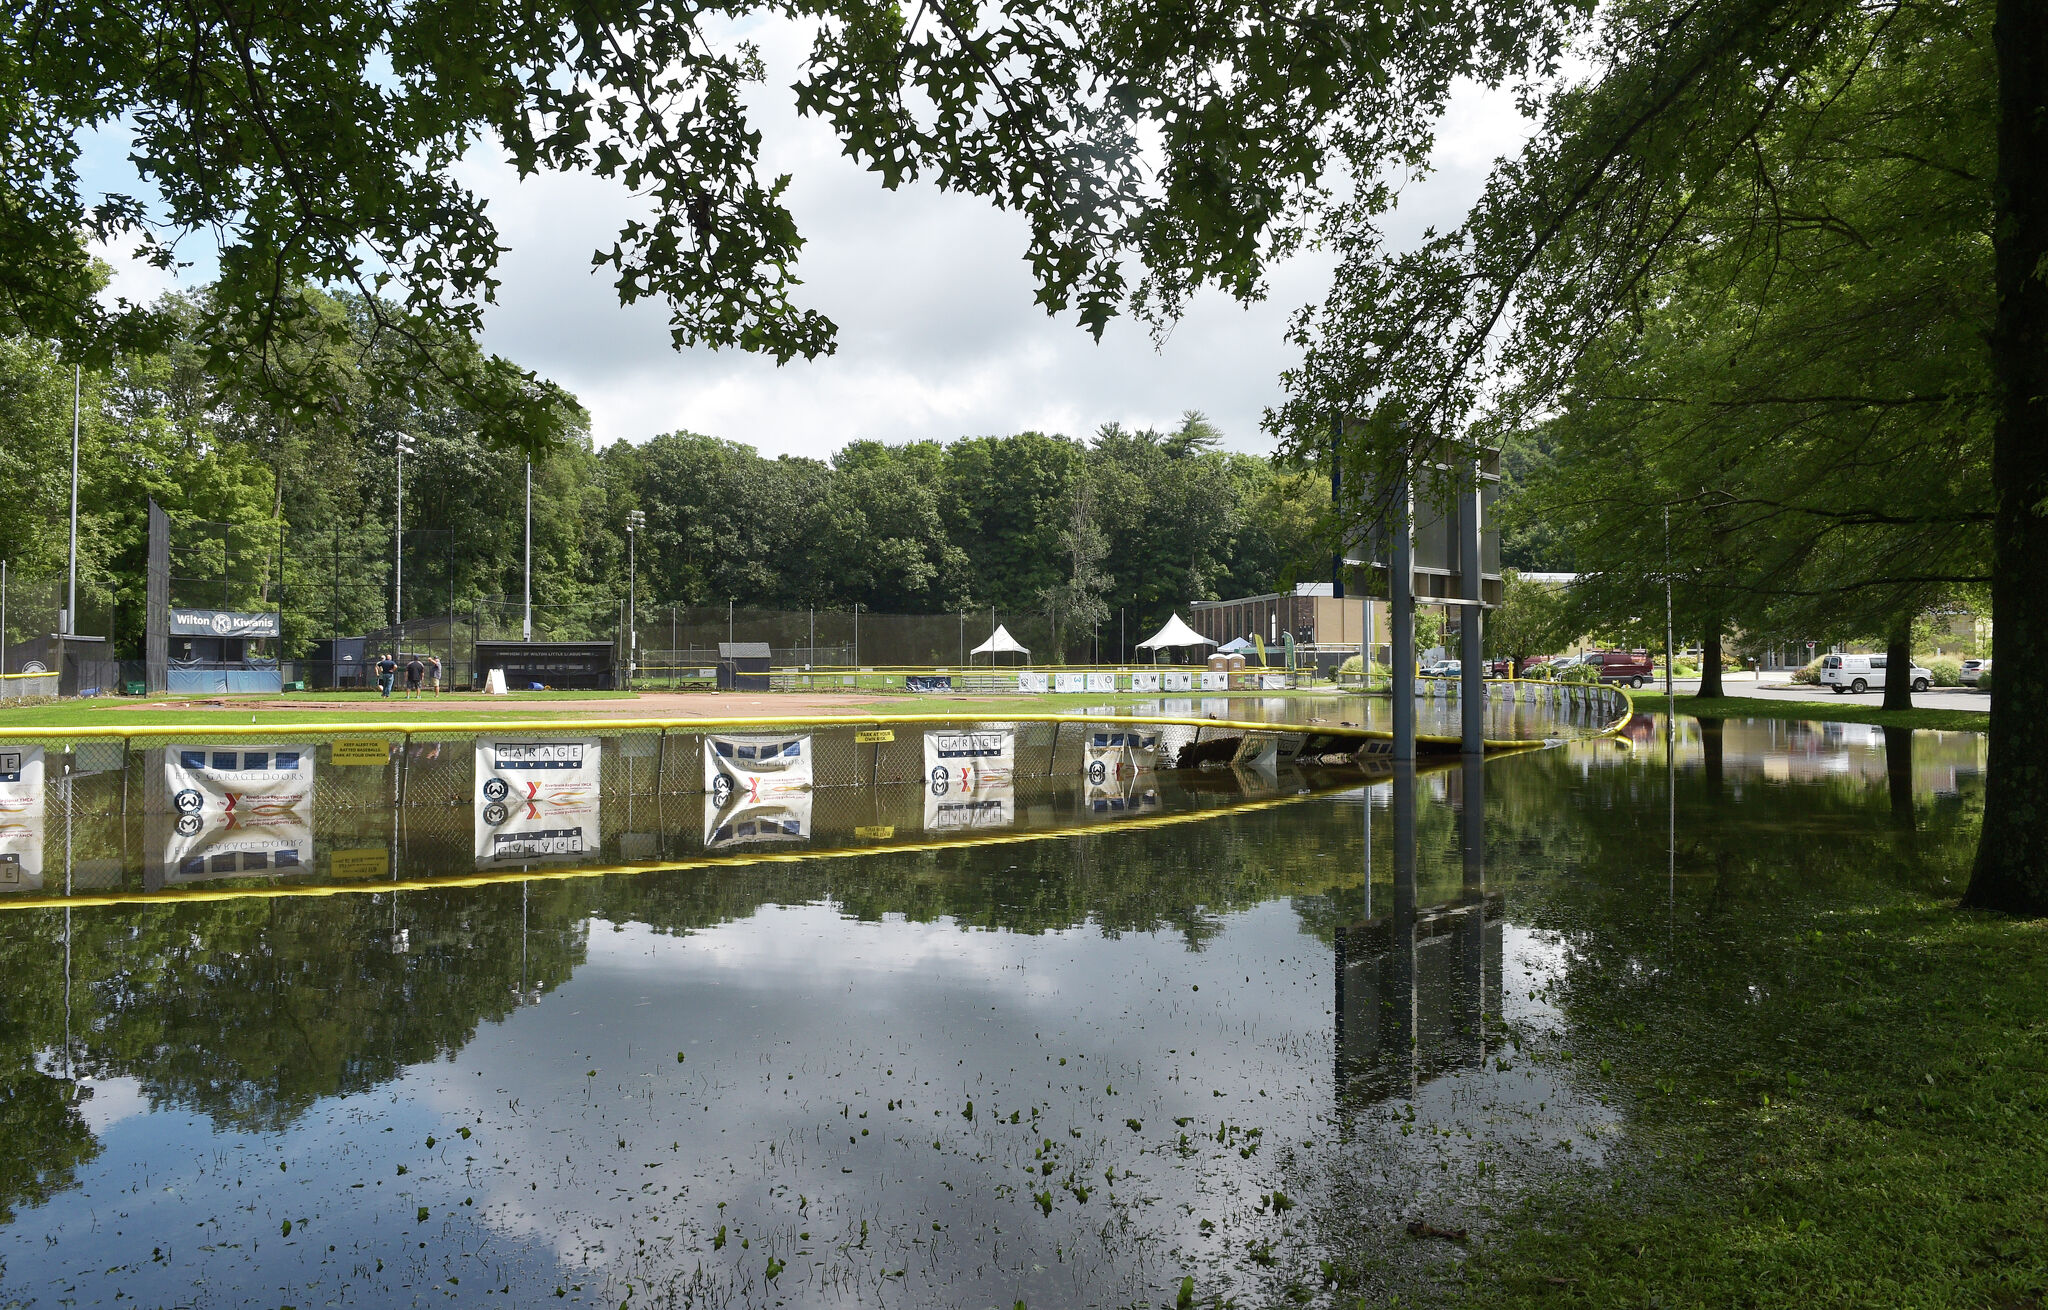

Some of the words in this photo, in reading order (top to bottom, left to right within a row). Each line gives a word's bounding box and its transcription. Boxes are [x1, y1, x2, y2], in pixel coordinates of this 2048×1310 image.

[176, 615, 210, 626] Wilton
[233, 618, 274, 628] Kiwanis
[941, 738, 998, 748] GARAGE
[499, 747, 579, 757] GARAGE
[206, 772, 256, 780] GARAGE
[262, 772, 304, 780] DOORS
